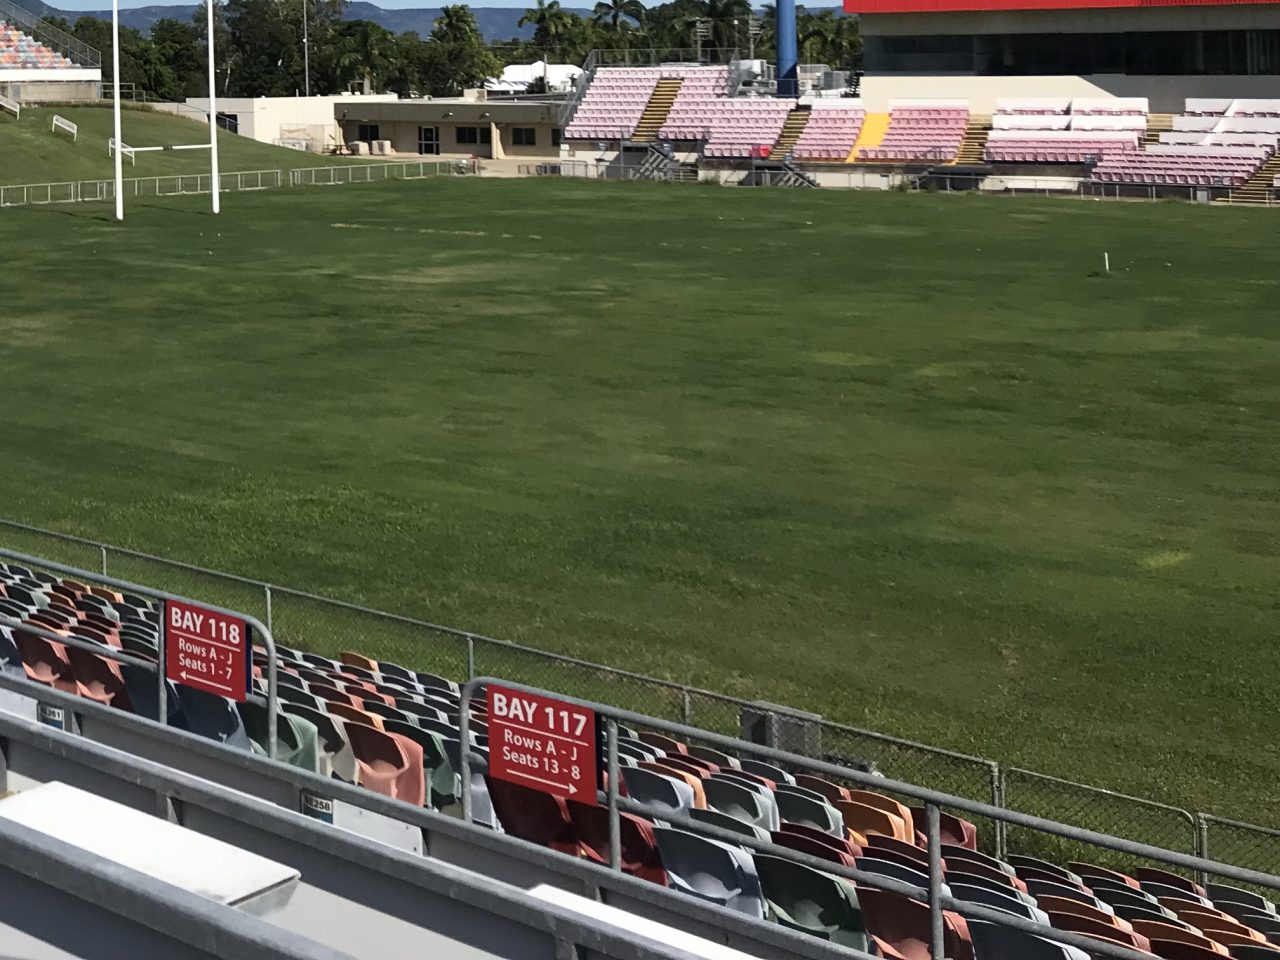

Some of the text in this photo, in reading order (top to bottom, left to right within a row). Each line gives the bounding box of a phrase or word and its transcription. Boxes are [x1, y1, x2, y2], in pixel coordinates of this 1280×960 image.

[171, 606, 240, 645] BAY 118
[178, 637, 207, 658] Rows
[209, 647, 217, 661] A
[227, 652, 232, 665] J
[178, 653, 207, 673] Seats
[210, 662, 215, 675] 1
[225, 667, 232, 680] 7
[493, 692, 587, 736] BAY 117
[504, 728, 542, 752] Rows
[546, 740, 557, 756] A
[570, 746, 577, 761] J
[502, 745, 539, 768] Seats
[543, 757, 559, 774] 13
[571, 765, 581, 780] 8
